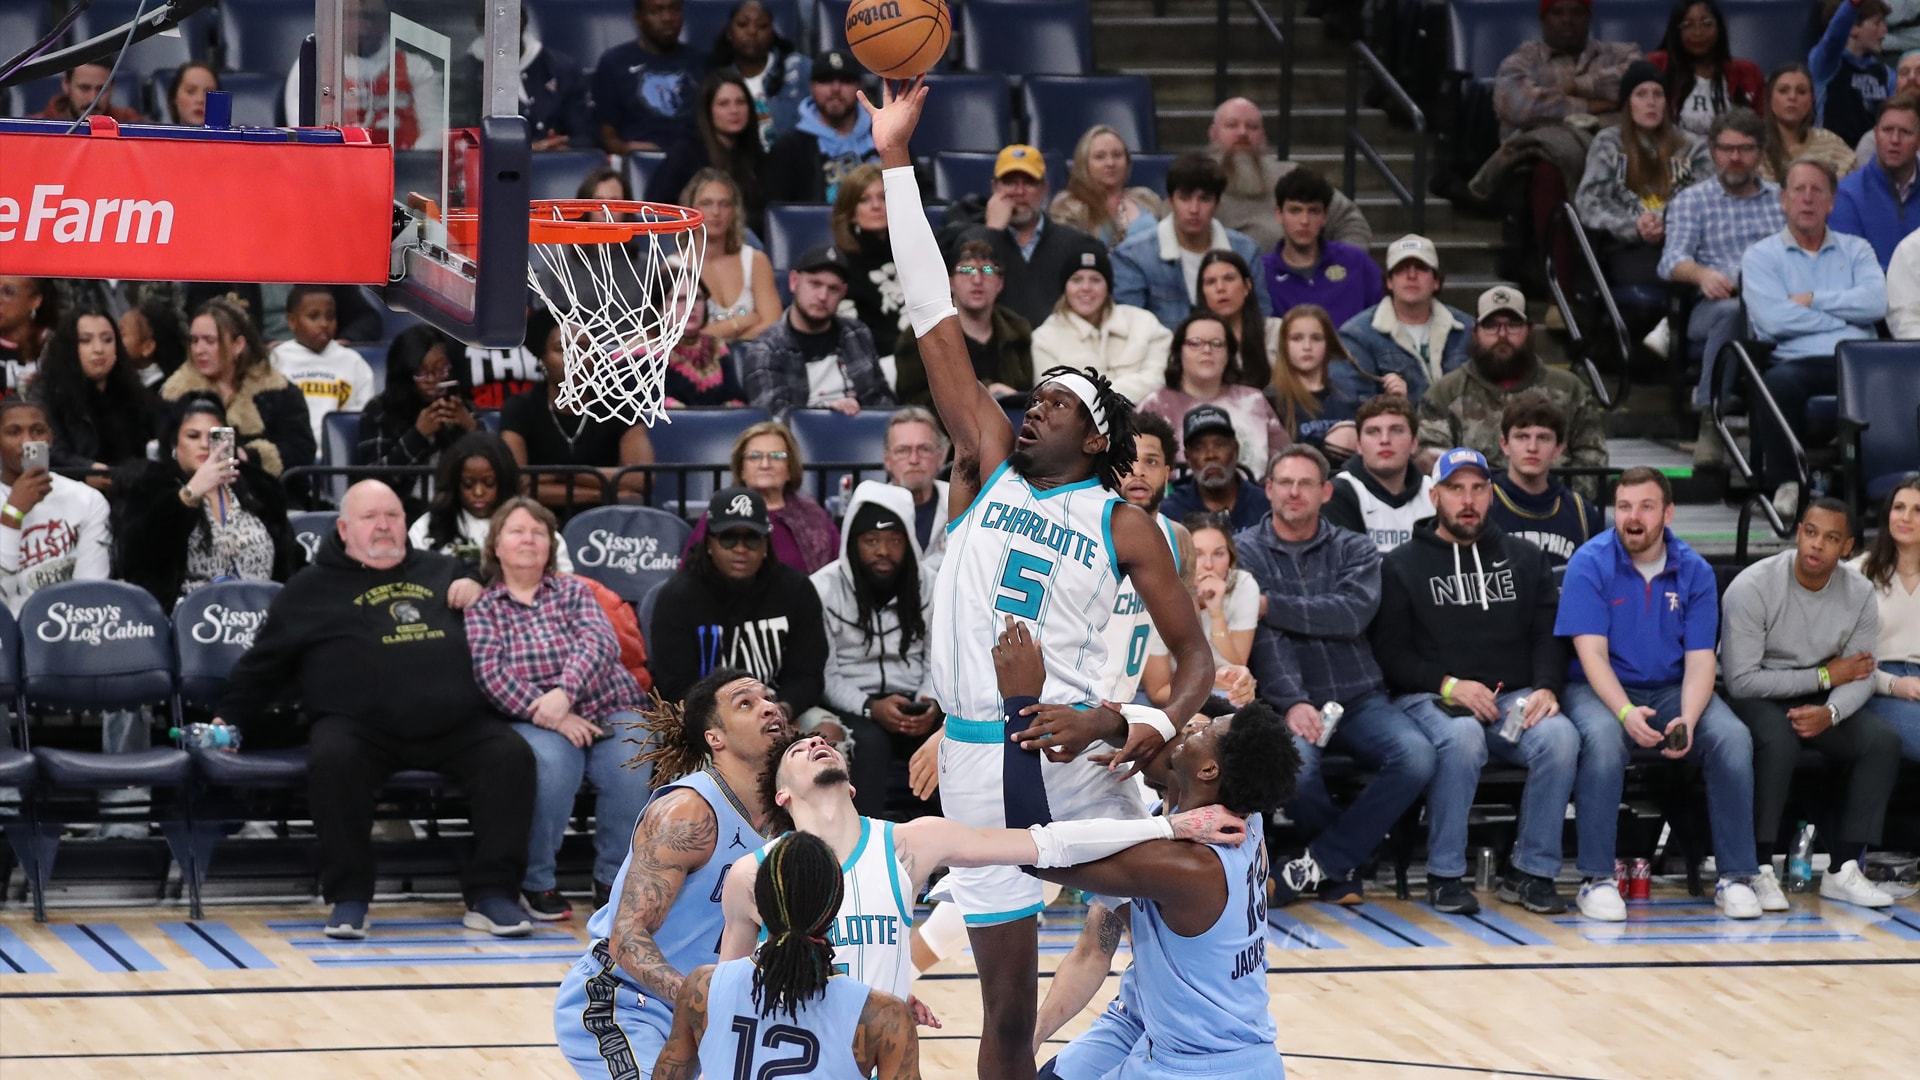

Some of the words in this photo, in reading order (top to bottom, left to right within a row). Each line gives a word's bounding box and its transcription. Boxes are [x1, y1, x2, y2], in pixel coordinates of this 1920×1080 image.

[846, 0, 902, 31] Wilson
[577, 529, 659, 567] Sissy's
[980, 501, 1098, 569] CHARLOTTE
[1507, 531, 1575, 559] MPHIS
[606, 550, 638, 575] Log
[639, 551, 682, 571] Cabi
[994, 548, 1053, 621] 5
[1429, 569, 1517, 606] NIKE
[37, 602, 121, 642] Sissy's
[69, 622, 102, 646] Log
[103, 620, 155, 640] Cabin
[192, 604, 268, 644] Sissy'
[1126, 624, 1150, 677] 0
[731, 1015, 821, 1080] 12
